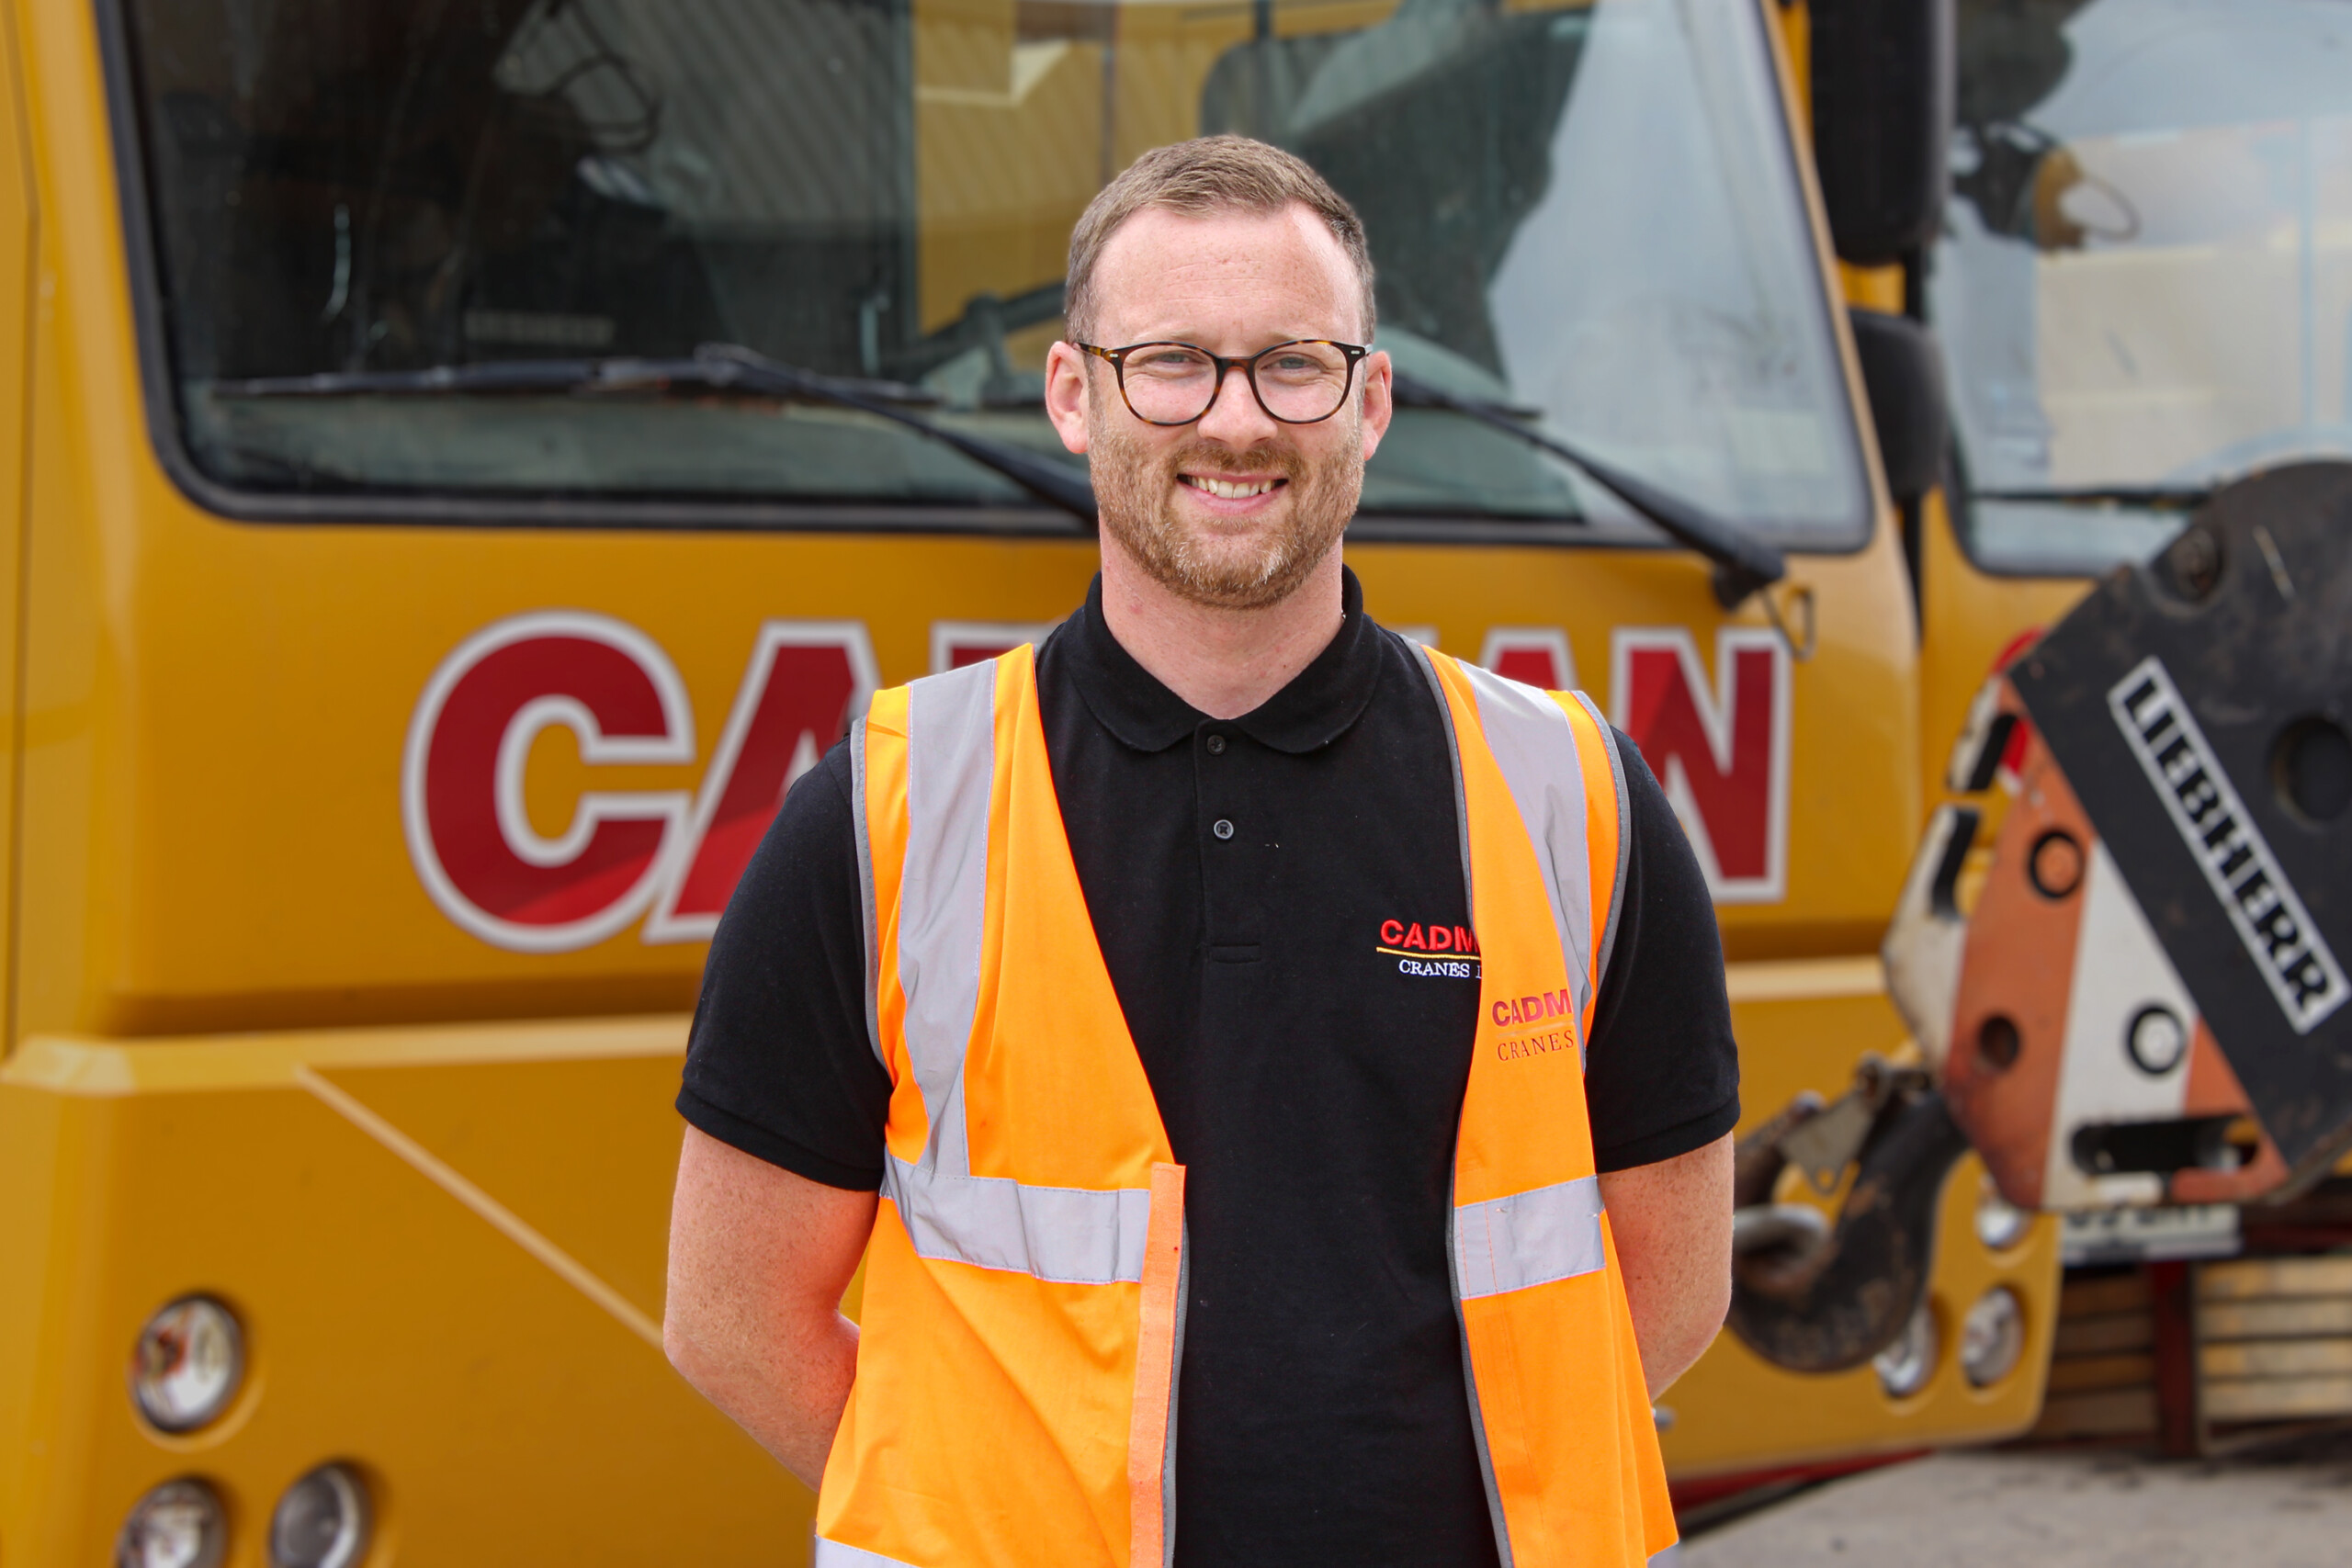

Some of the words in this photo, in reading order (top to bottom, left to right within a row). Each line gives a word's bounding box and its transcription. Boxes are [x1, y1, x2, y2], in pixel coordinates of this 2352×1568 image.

[2122, 676, 2331, 1008] LIEBHERR
[1398, 959, 1470, 978] CRANES
[1498, 1030, 1574, 1062] CRANES
